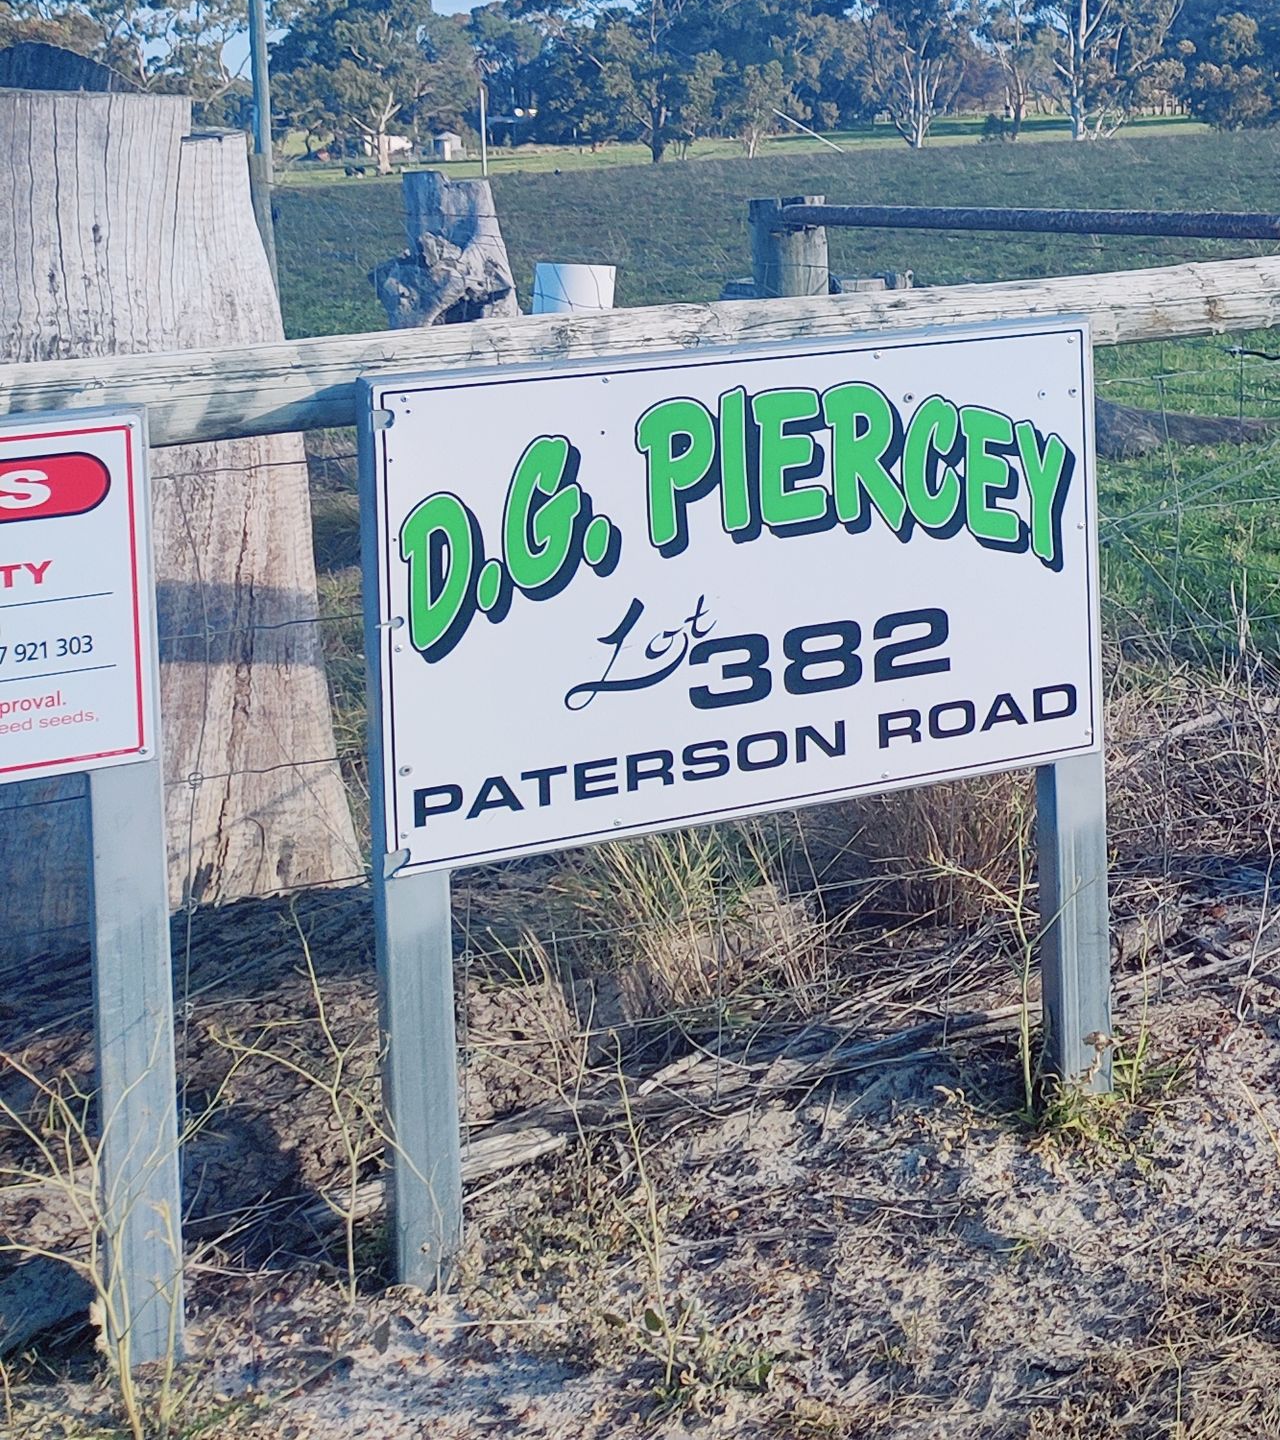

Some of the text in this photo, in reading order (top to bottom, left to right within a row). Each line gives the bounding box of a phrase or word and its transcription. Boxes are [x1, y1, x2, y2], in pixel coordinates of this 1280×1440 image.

[399, 380, 1076, 664] D.G. PIERCEY
[14, 641, 48, 663] 921
[56, 635, 94, 657] 303
[564, 594, 951, 711] Lot 382
[413, 683, 1077, 828] PATERSON ROAD
